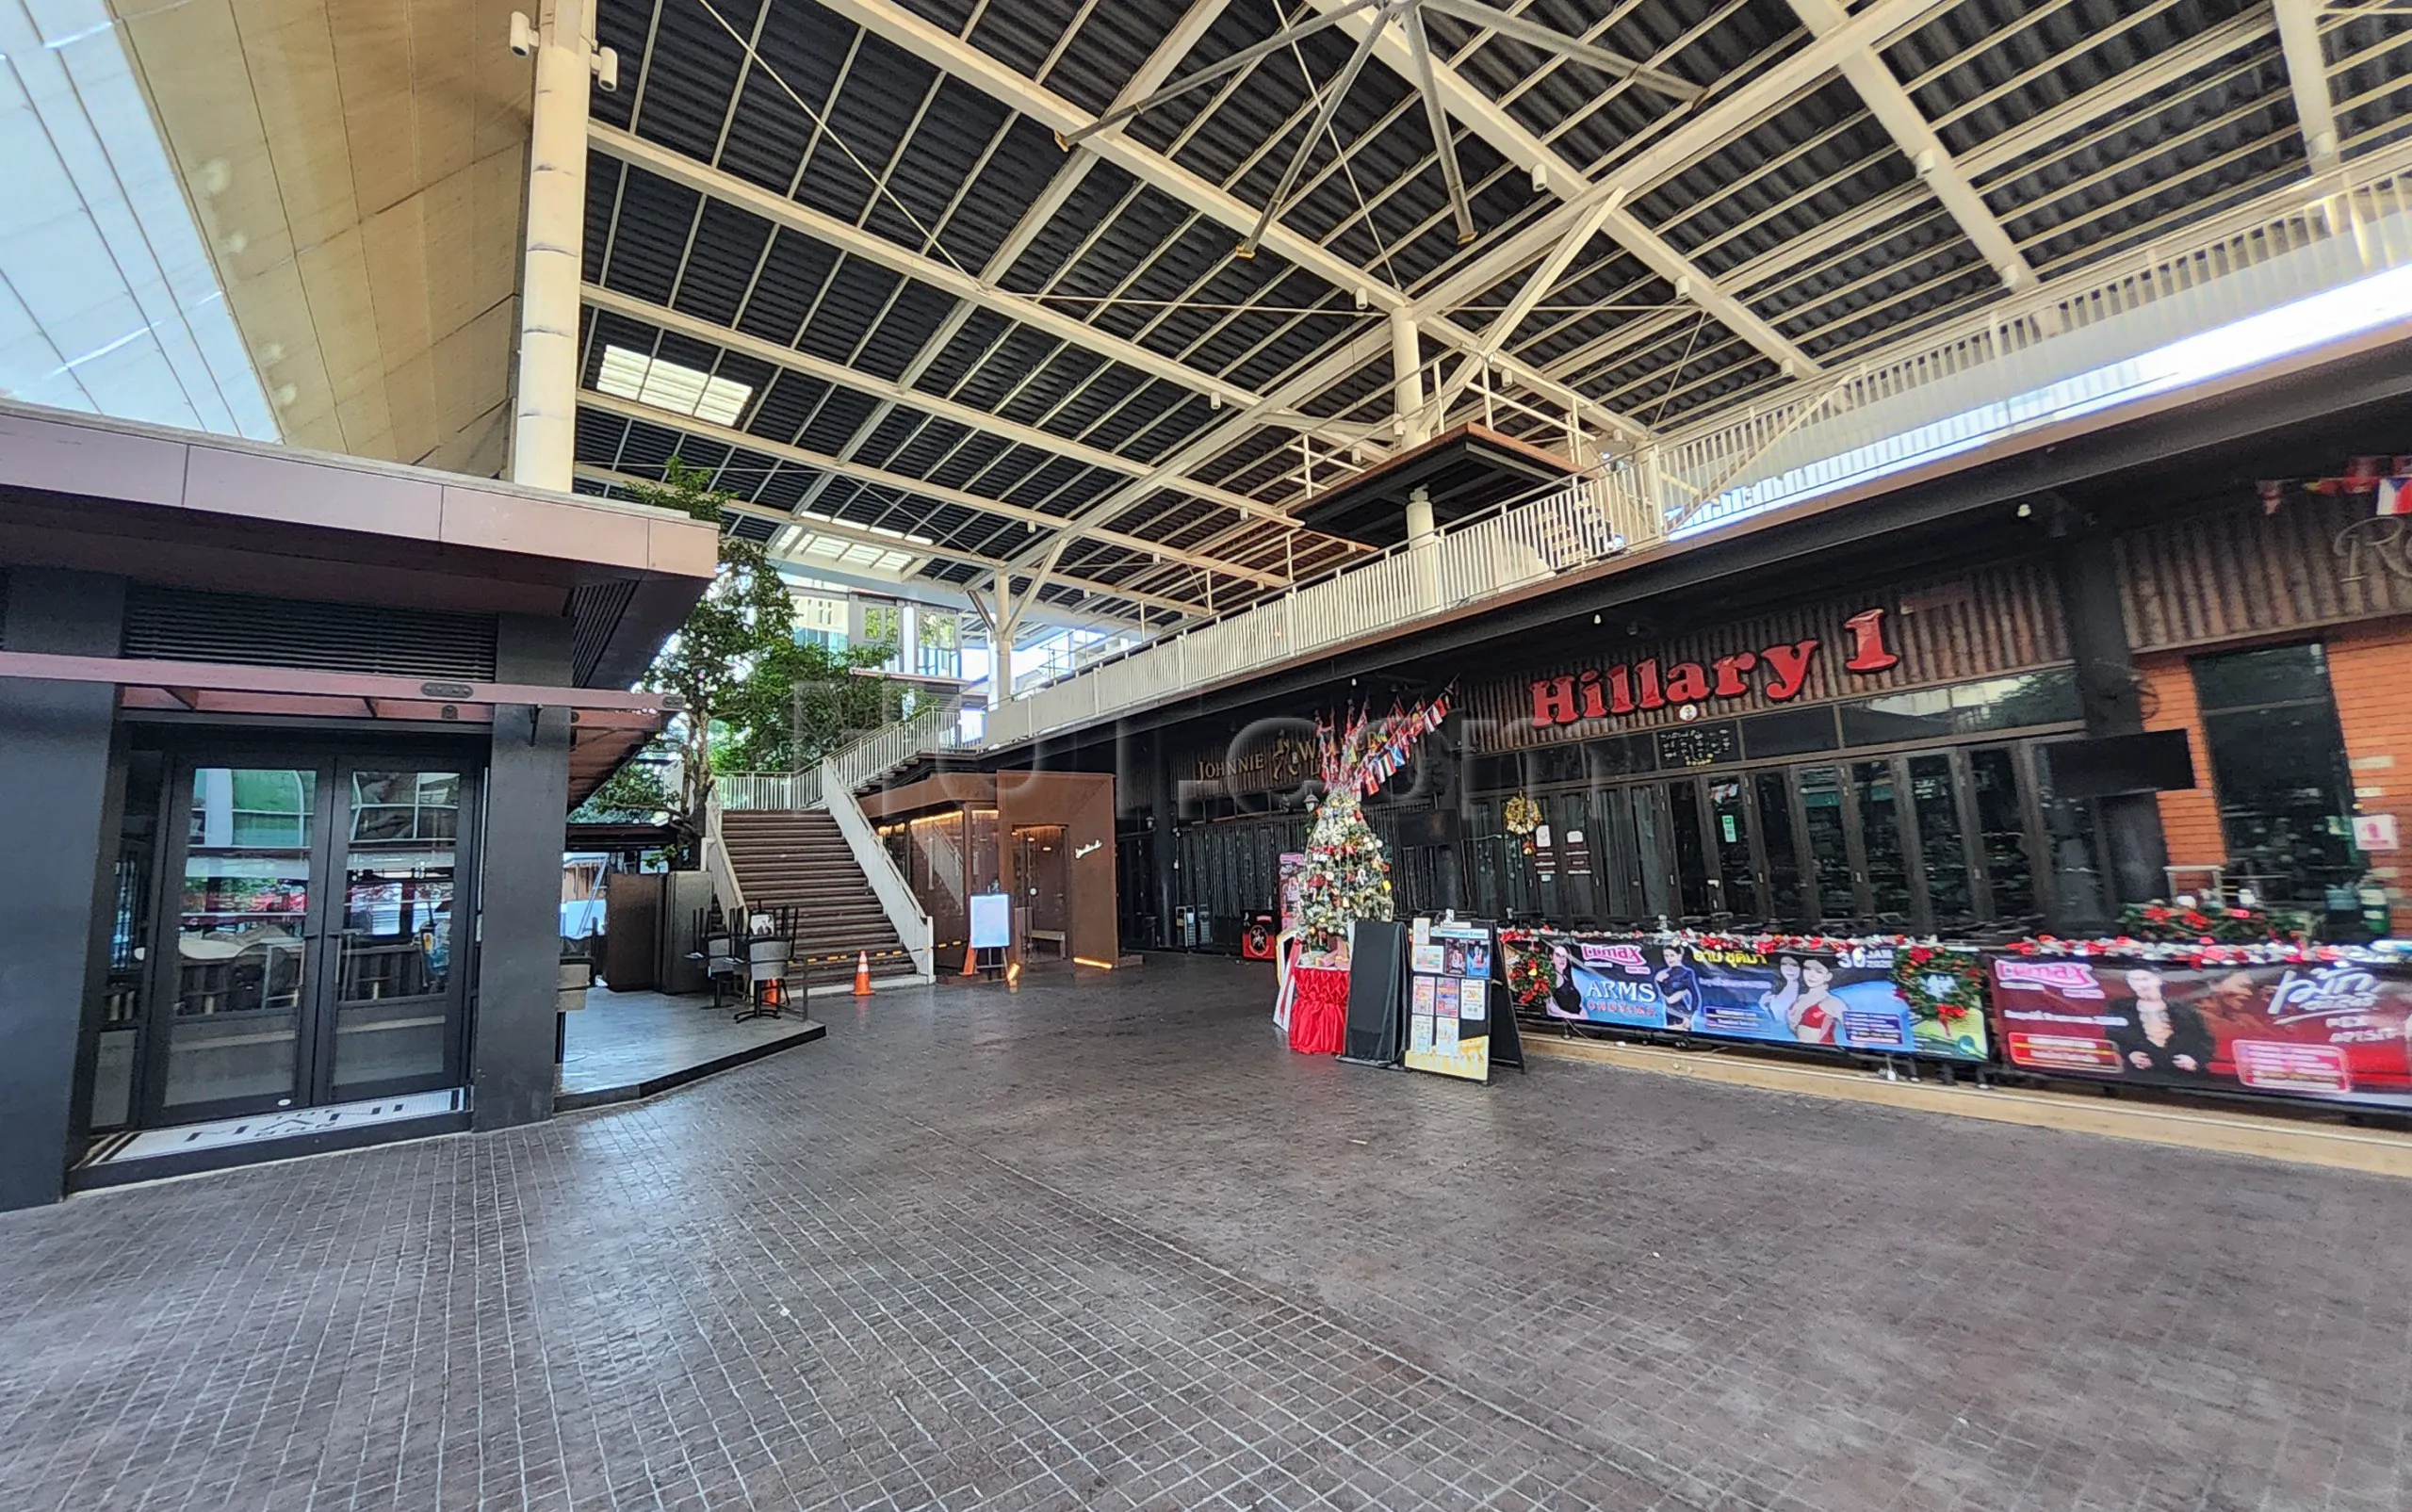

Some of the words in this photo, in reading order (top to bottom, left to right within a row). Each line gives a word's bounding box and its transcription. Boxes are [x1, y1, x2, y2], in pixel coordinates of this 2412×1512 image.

[1530, 639, 1819, 728] Hillary
[1843, 608, 1899, 672] 1
[1197, 753, 1265, 784] JOHNNIE
[1587, 980, 1656, 1003] ARMS
